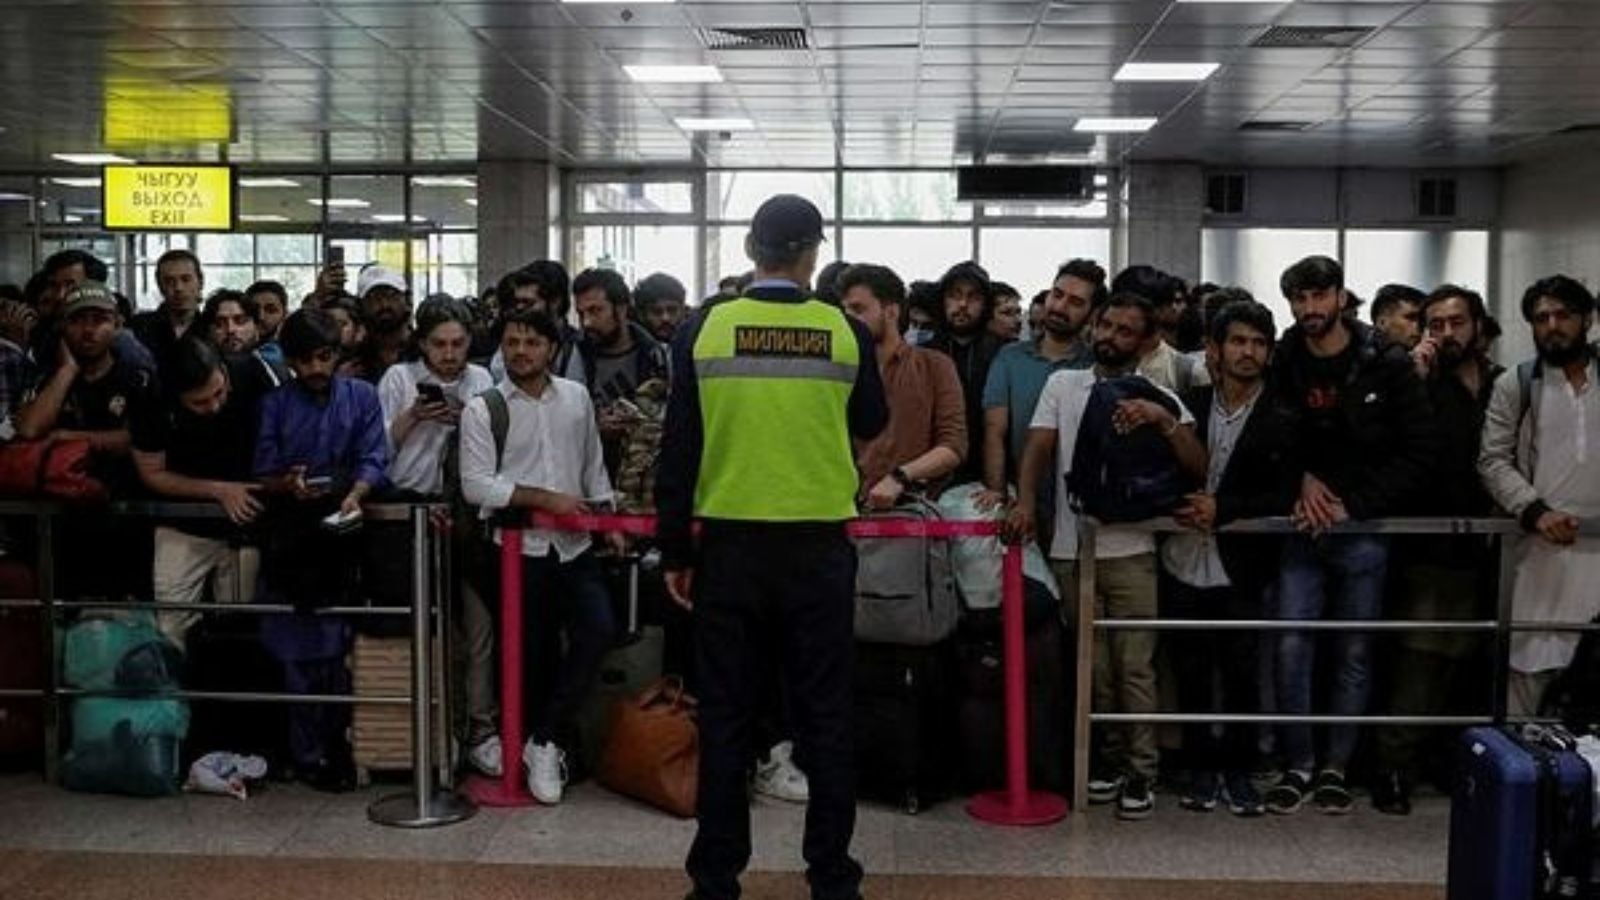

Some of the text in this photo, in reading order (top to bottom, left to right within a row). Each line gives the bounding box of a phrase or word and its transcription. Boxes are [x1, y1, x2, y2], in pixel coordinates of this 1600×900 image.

[136, 172, 198, 188] ЧЫГУУ
[132, 191, 203, 207] ВЫХОД
[150, 210, 186, 225] EXIT
[738, 328, 827, 353] МИЛИЦИЯ
